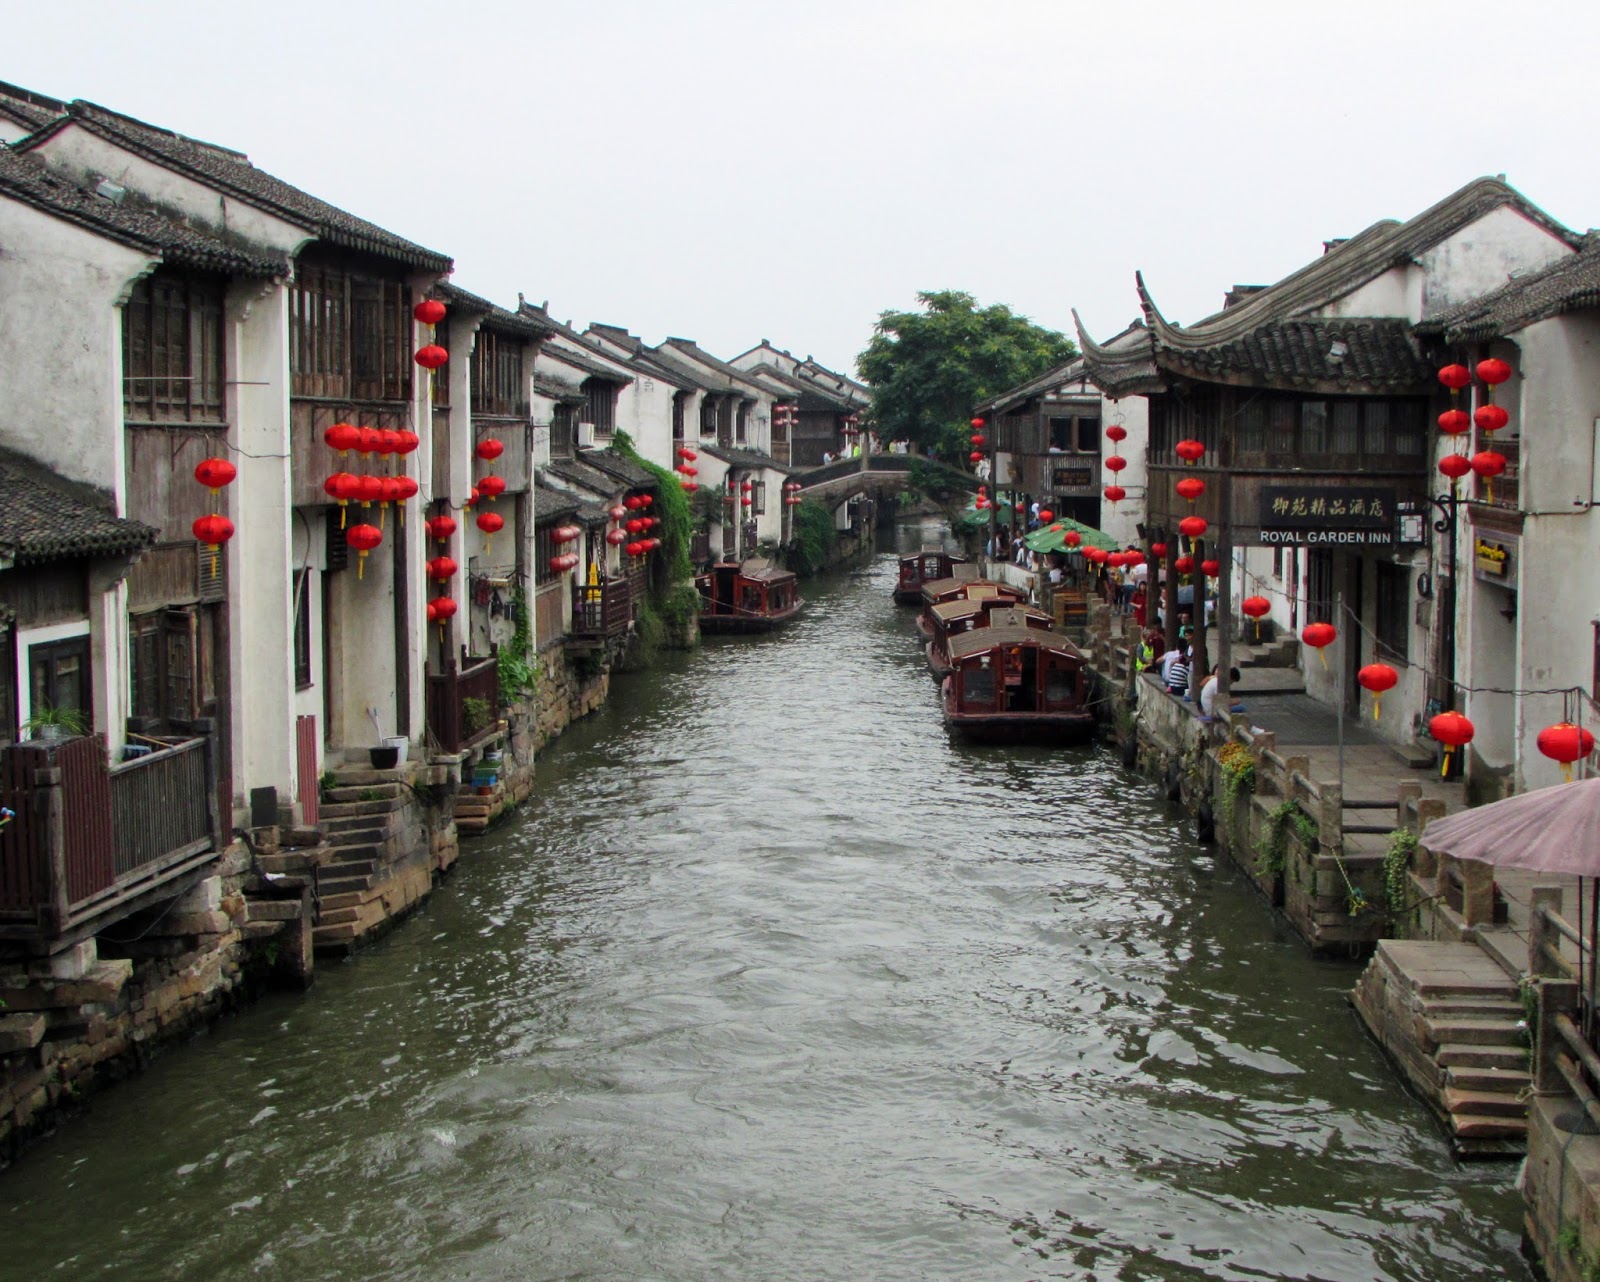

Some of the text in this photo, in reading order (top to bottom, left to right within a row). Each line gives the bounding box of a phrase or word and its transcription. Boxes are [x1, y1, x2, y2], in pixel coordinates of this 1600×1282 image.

[1272, 497, 1383, 516] 御苑精品酒店
[1260, 531, 1391, 544] ROYAL GARDEN INN
